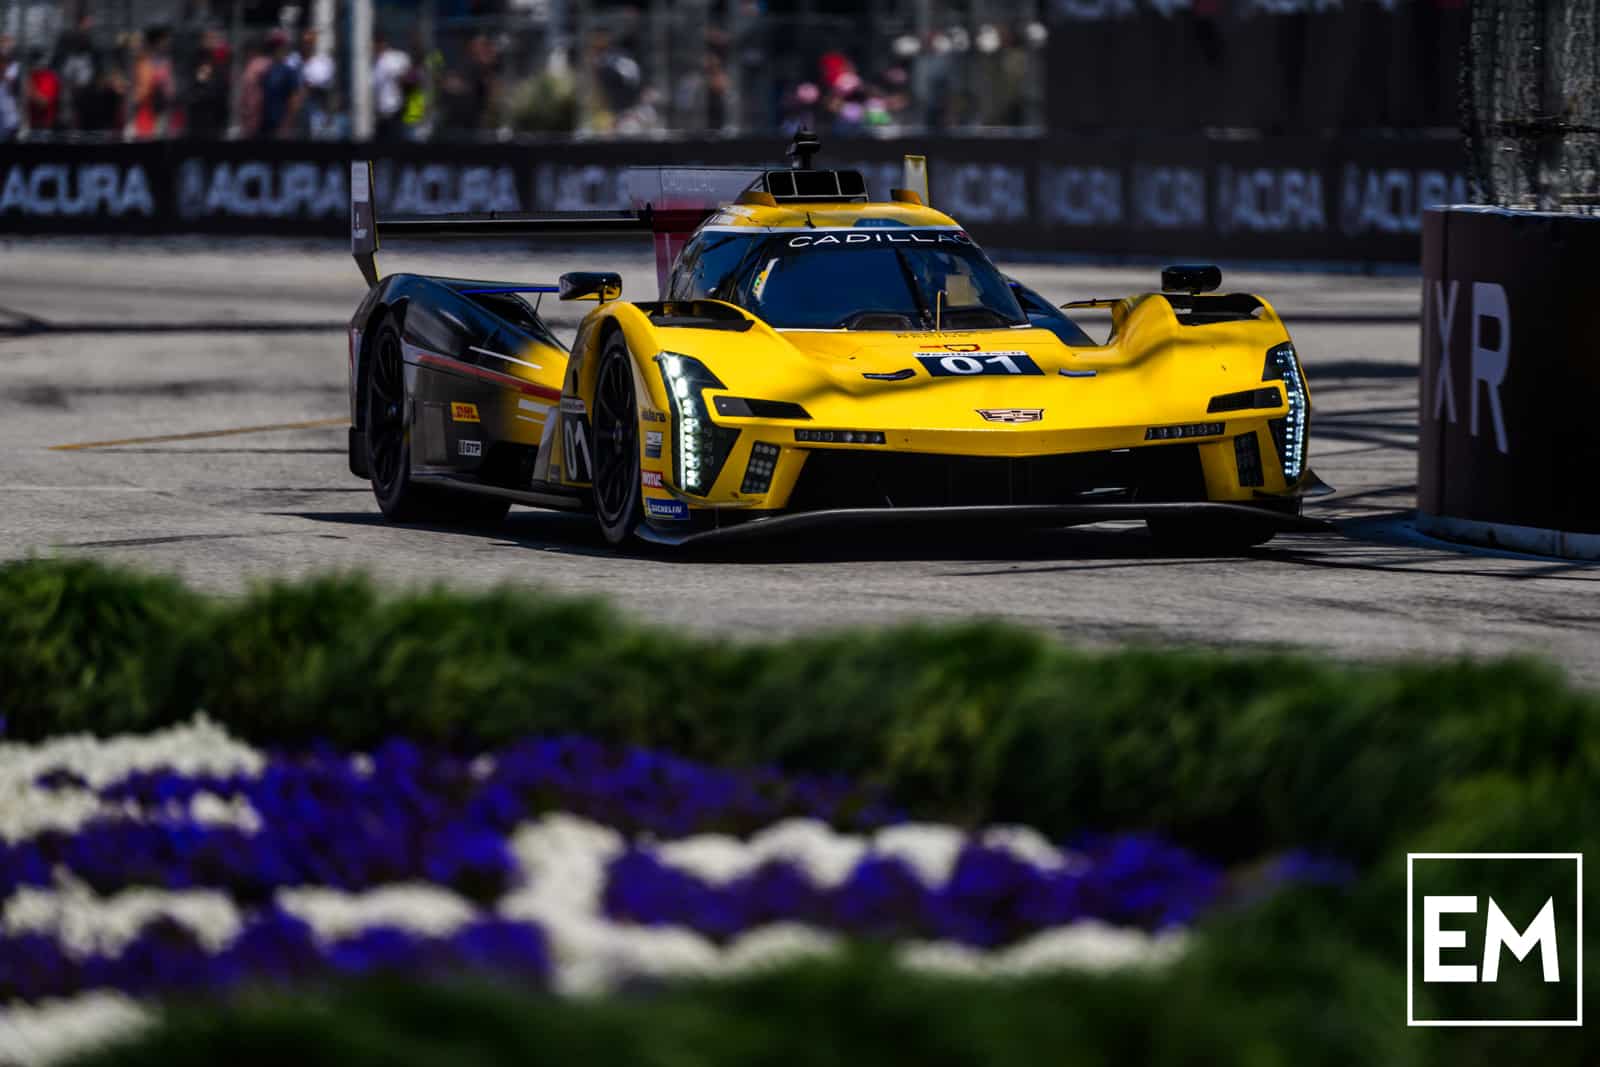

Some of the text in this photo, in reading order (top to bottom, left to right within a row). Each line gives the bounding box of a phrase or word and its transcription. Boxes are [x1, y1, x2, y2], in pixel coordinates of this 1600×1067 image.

[3, 163, 153, 215] ACURA
[206, 162, 349, 215] ACURA
[392, 163, 521, 214] ACURA
[940, 356, 1022, 374] 01
[454, 405, 479, 419] DHL
